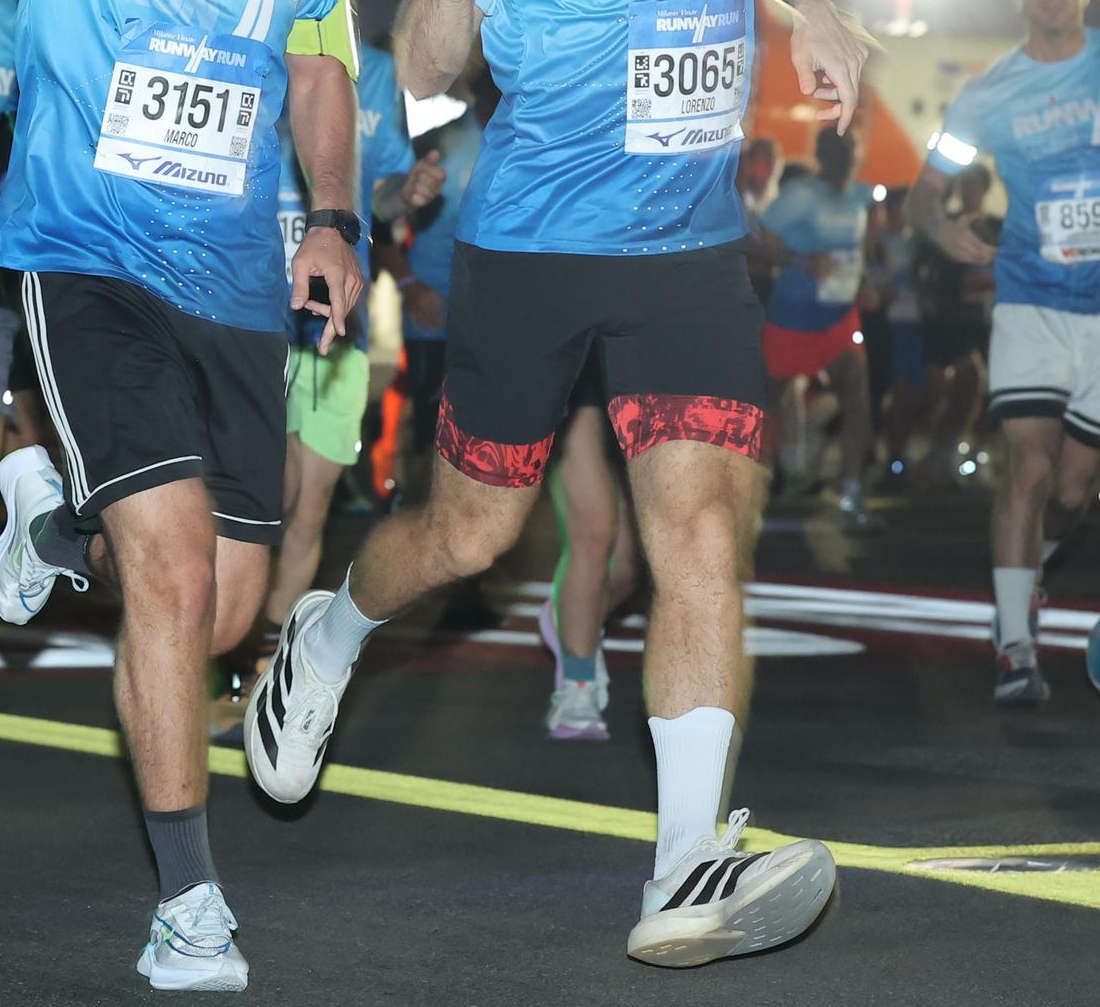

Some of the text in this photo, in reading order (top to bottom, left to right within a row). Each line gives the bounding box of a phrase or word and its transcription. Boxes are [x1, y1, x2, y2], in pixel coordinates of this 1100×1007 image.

[653, 46, 736, 98] 3065
[142, 75, 230, 133] 3151
[681, 96, 716, 115] LORENZO
[164, 128, 199, 148] MARCO
[280, 215, 306, 244] 16
